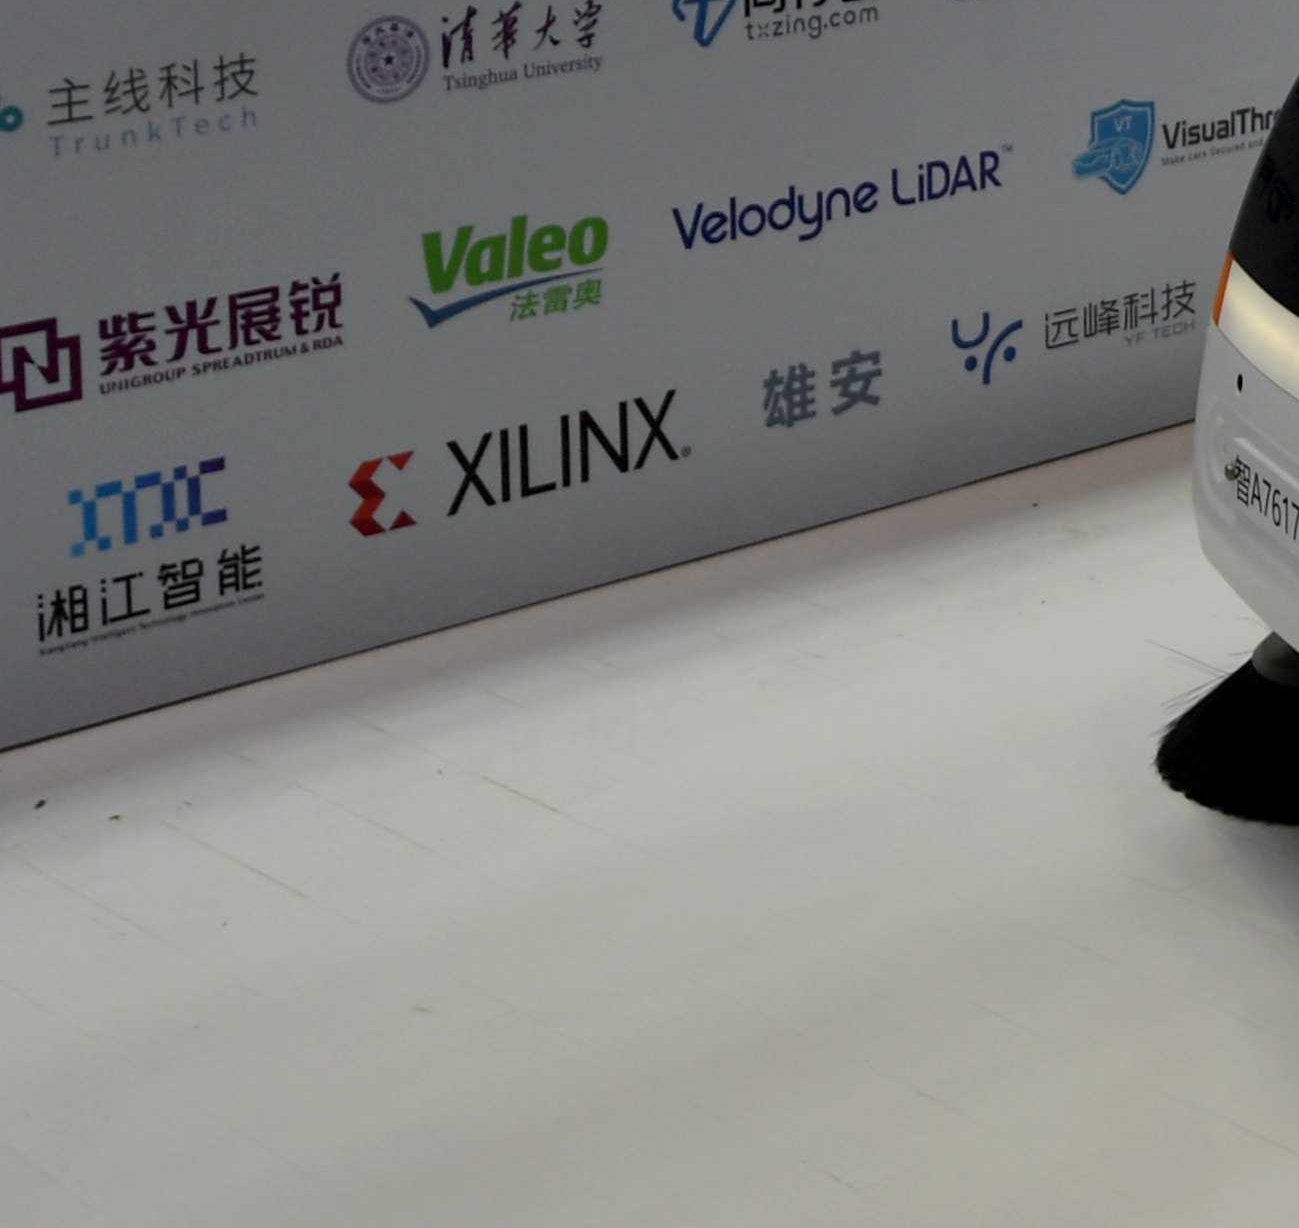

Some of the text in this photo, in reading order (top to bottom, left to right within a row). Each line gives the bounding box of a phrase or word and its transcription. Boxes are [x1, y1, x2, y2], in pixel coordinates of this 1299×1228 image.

[46, 52, 259, 127] 主线科技
[443, 54, 604, 93] Tsinghua University
[1162, 107, 1282, 150] VisualThr
[672, 150, 1001, 251] Velodyne LiDAR
[421, 214, 609, 295] Valeo
[98, 273, 344, 376] 紫光展锐
[509, 278, 603, 323] 法雷奥
[1044, 280, 1198, 351] 远峰科技
[1151, 319, 1196, 342] TECH
[99, 367, 187, 395] UNIGROUP
[192, 344, 297, 376] SPREADTRUM
[312, 334, 344, 352] RDA
[762, 349, 884, 431] 雄安
[446, 388, 679, 518] XILINX
[37, 544, 263, 643] 湘江智能
